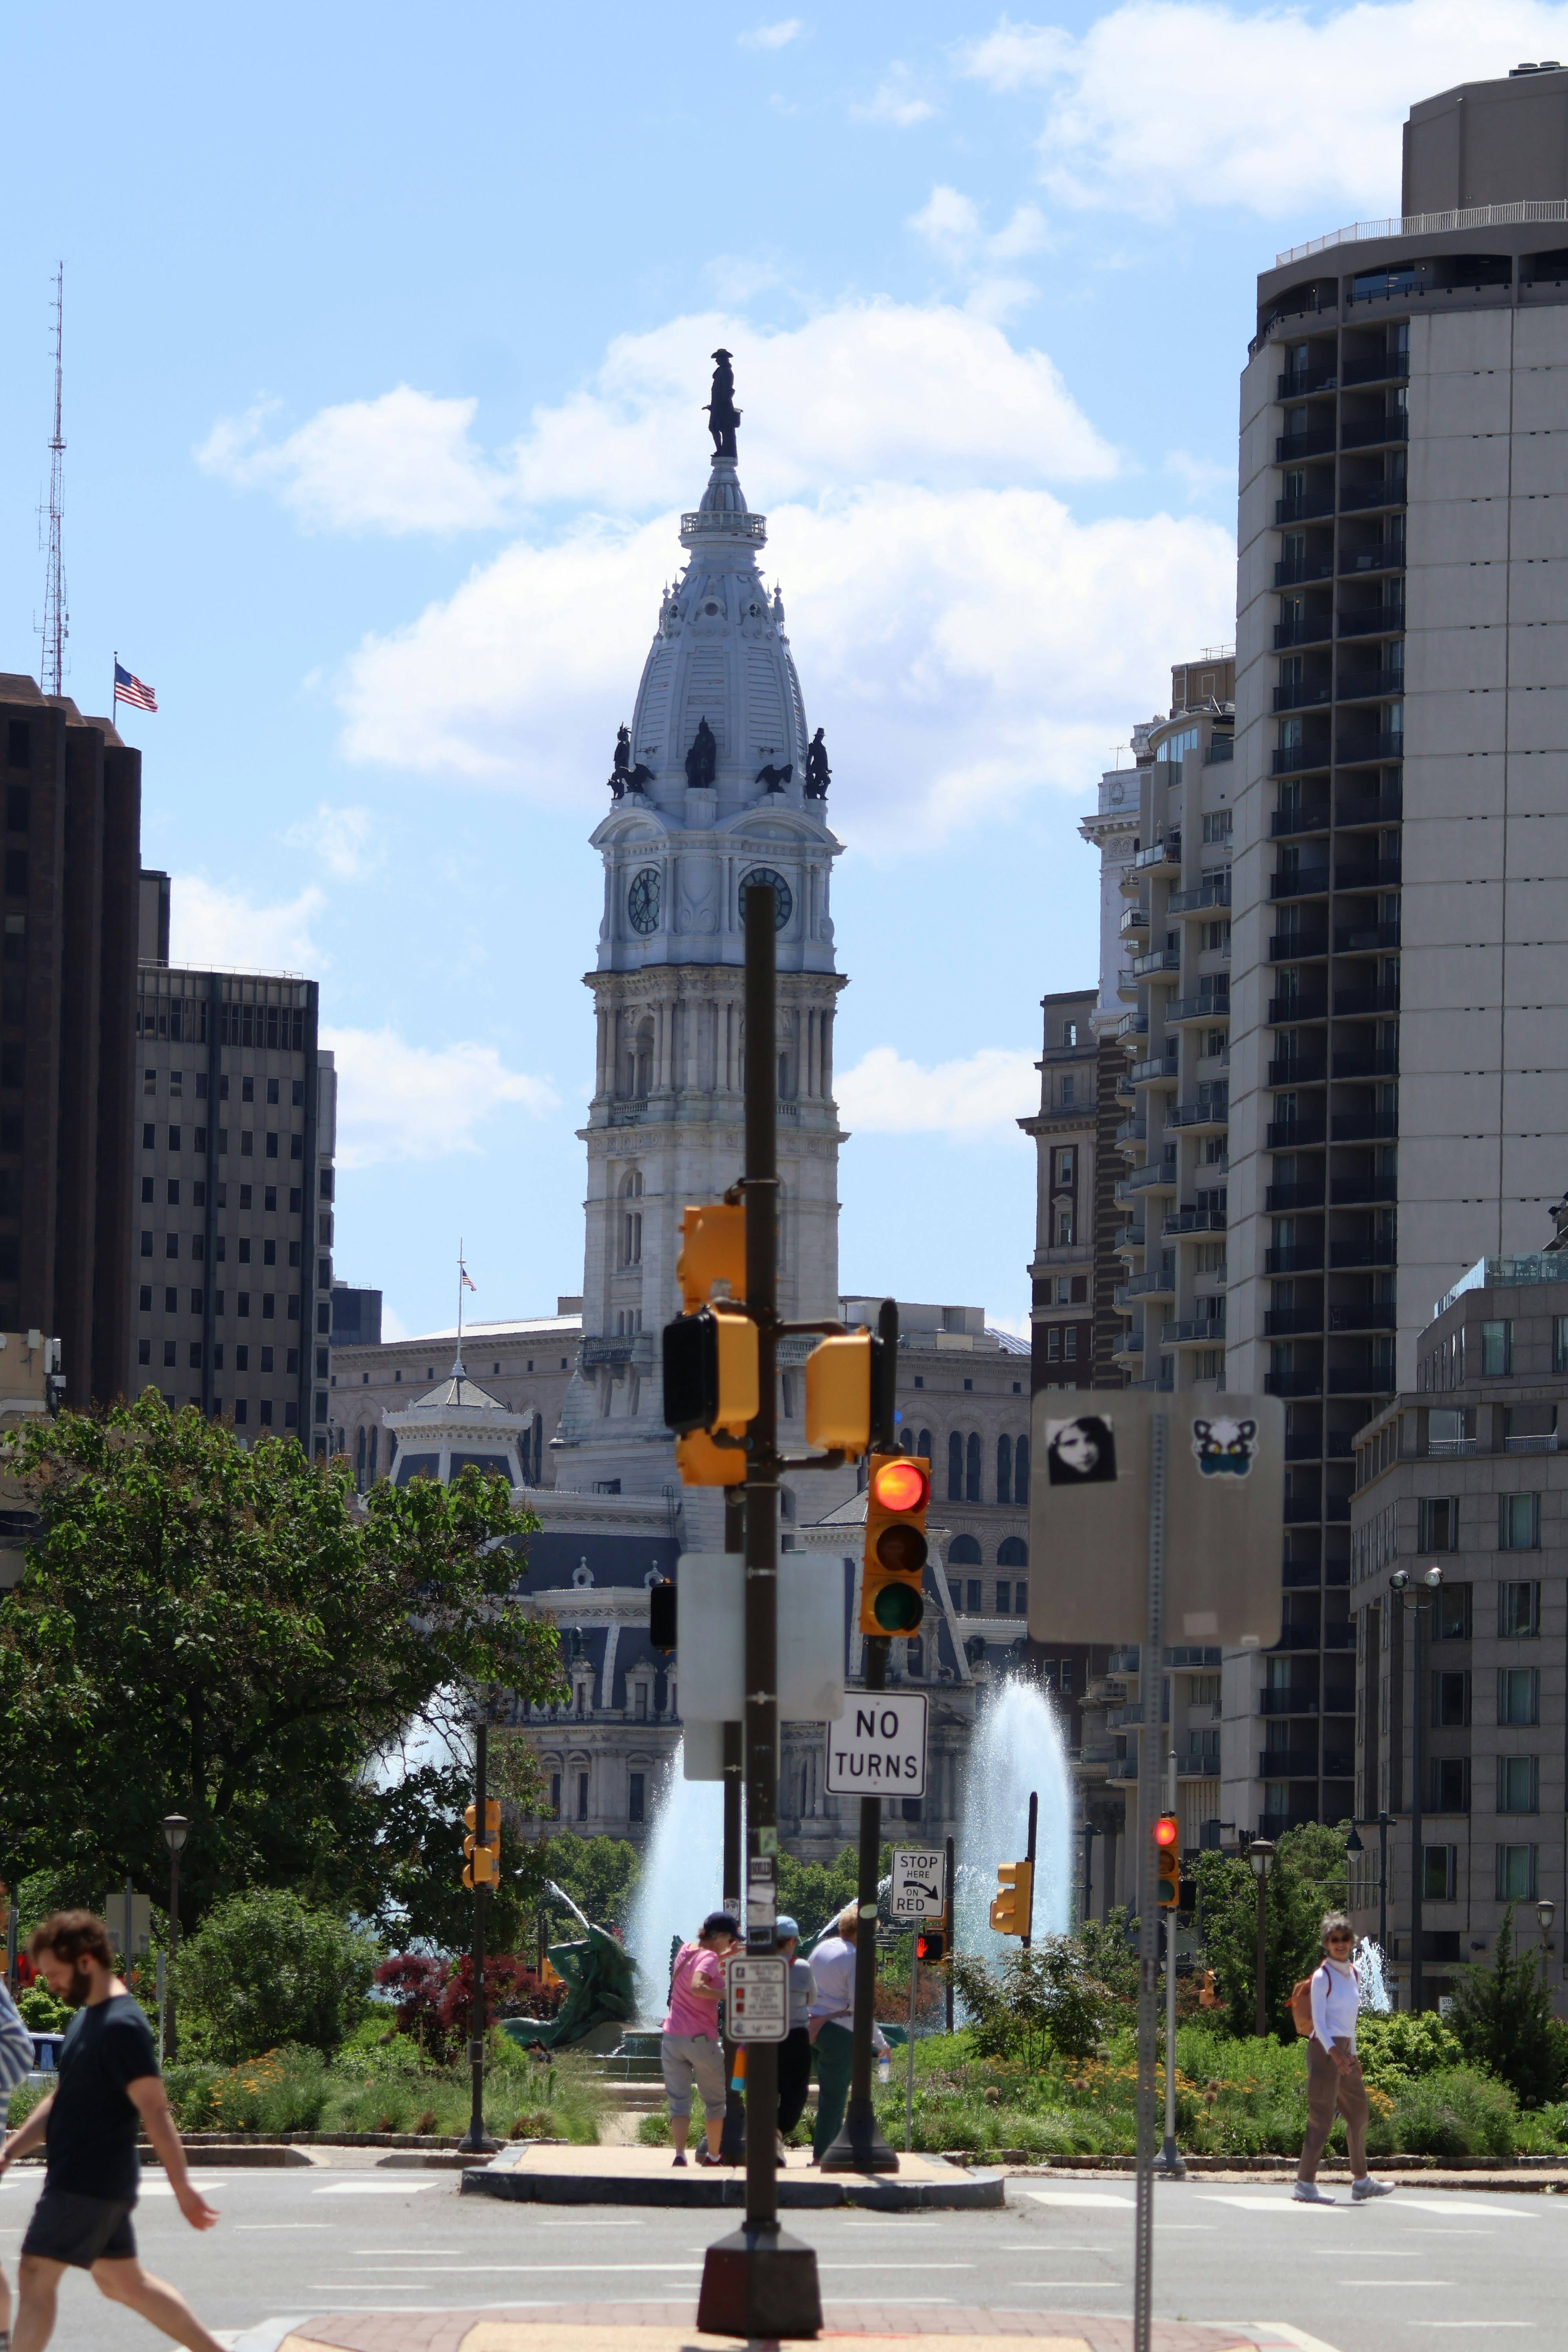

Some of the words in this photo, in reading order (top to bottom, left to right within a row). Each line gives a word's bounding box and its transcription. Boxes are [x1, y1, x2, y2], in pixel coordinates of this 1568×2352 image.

[857, 1710, 898, 1739] NO
[835, 1753, 917, 1779] TURNS
[900, 1856, 938, 1869] STOP
[907, 1870, 930, 1878] HERE
[897, 1898, 925, 1911] RED
